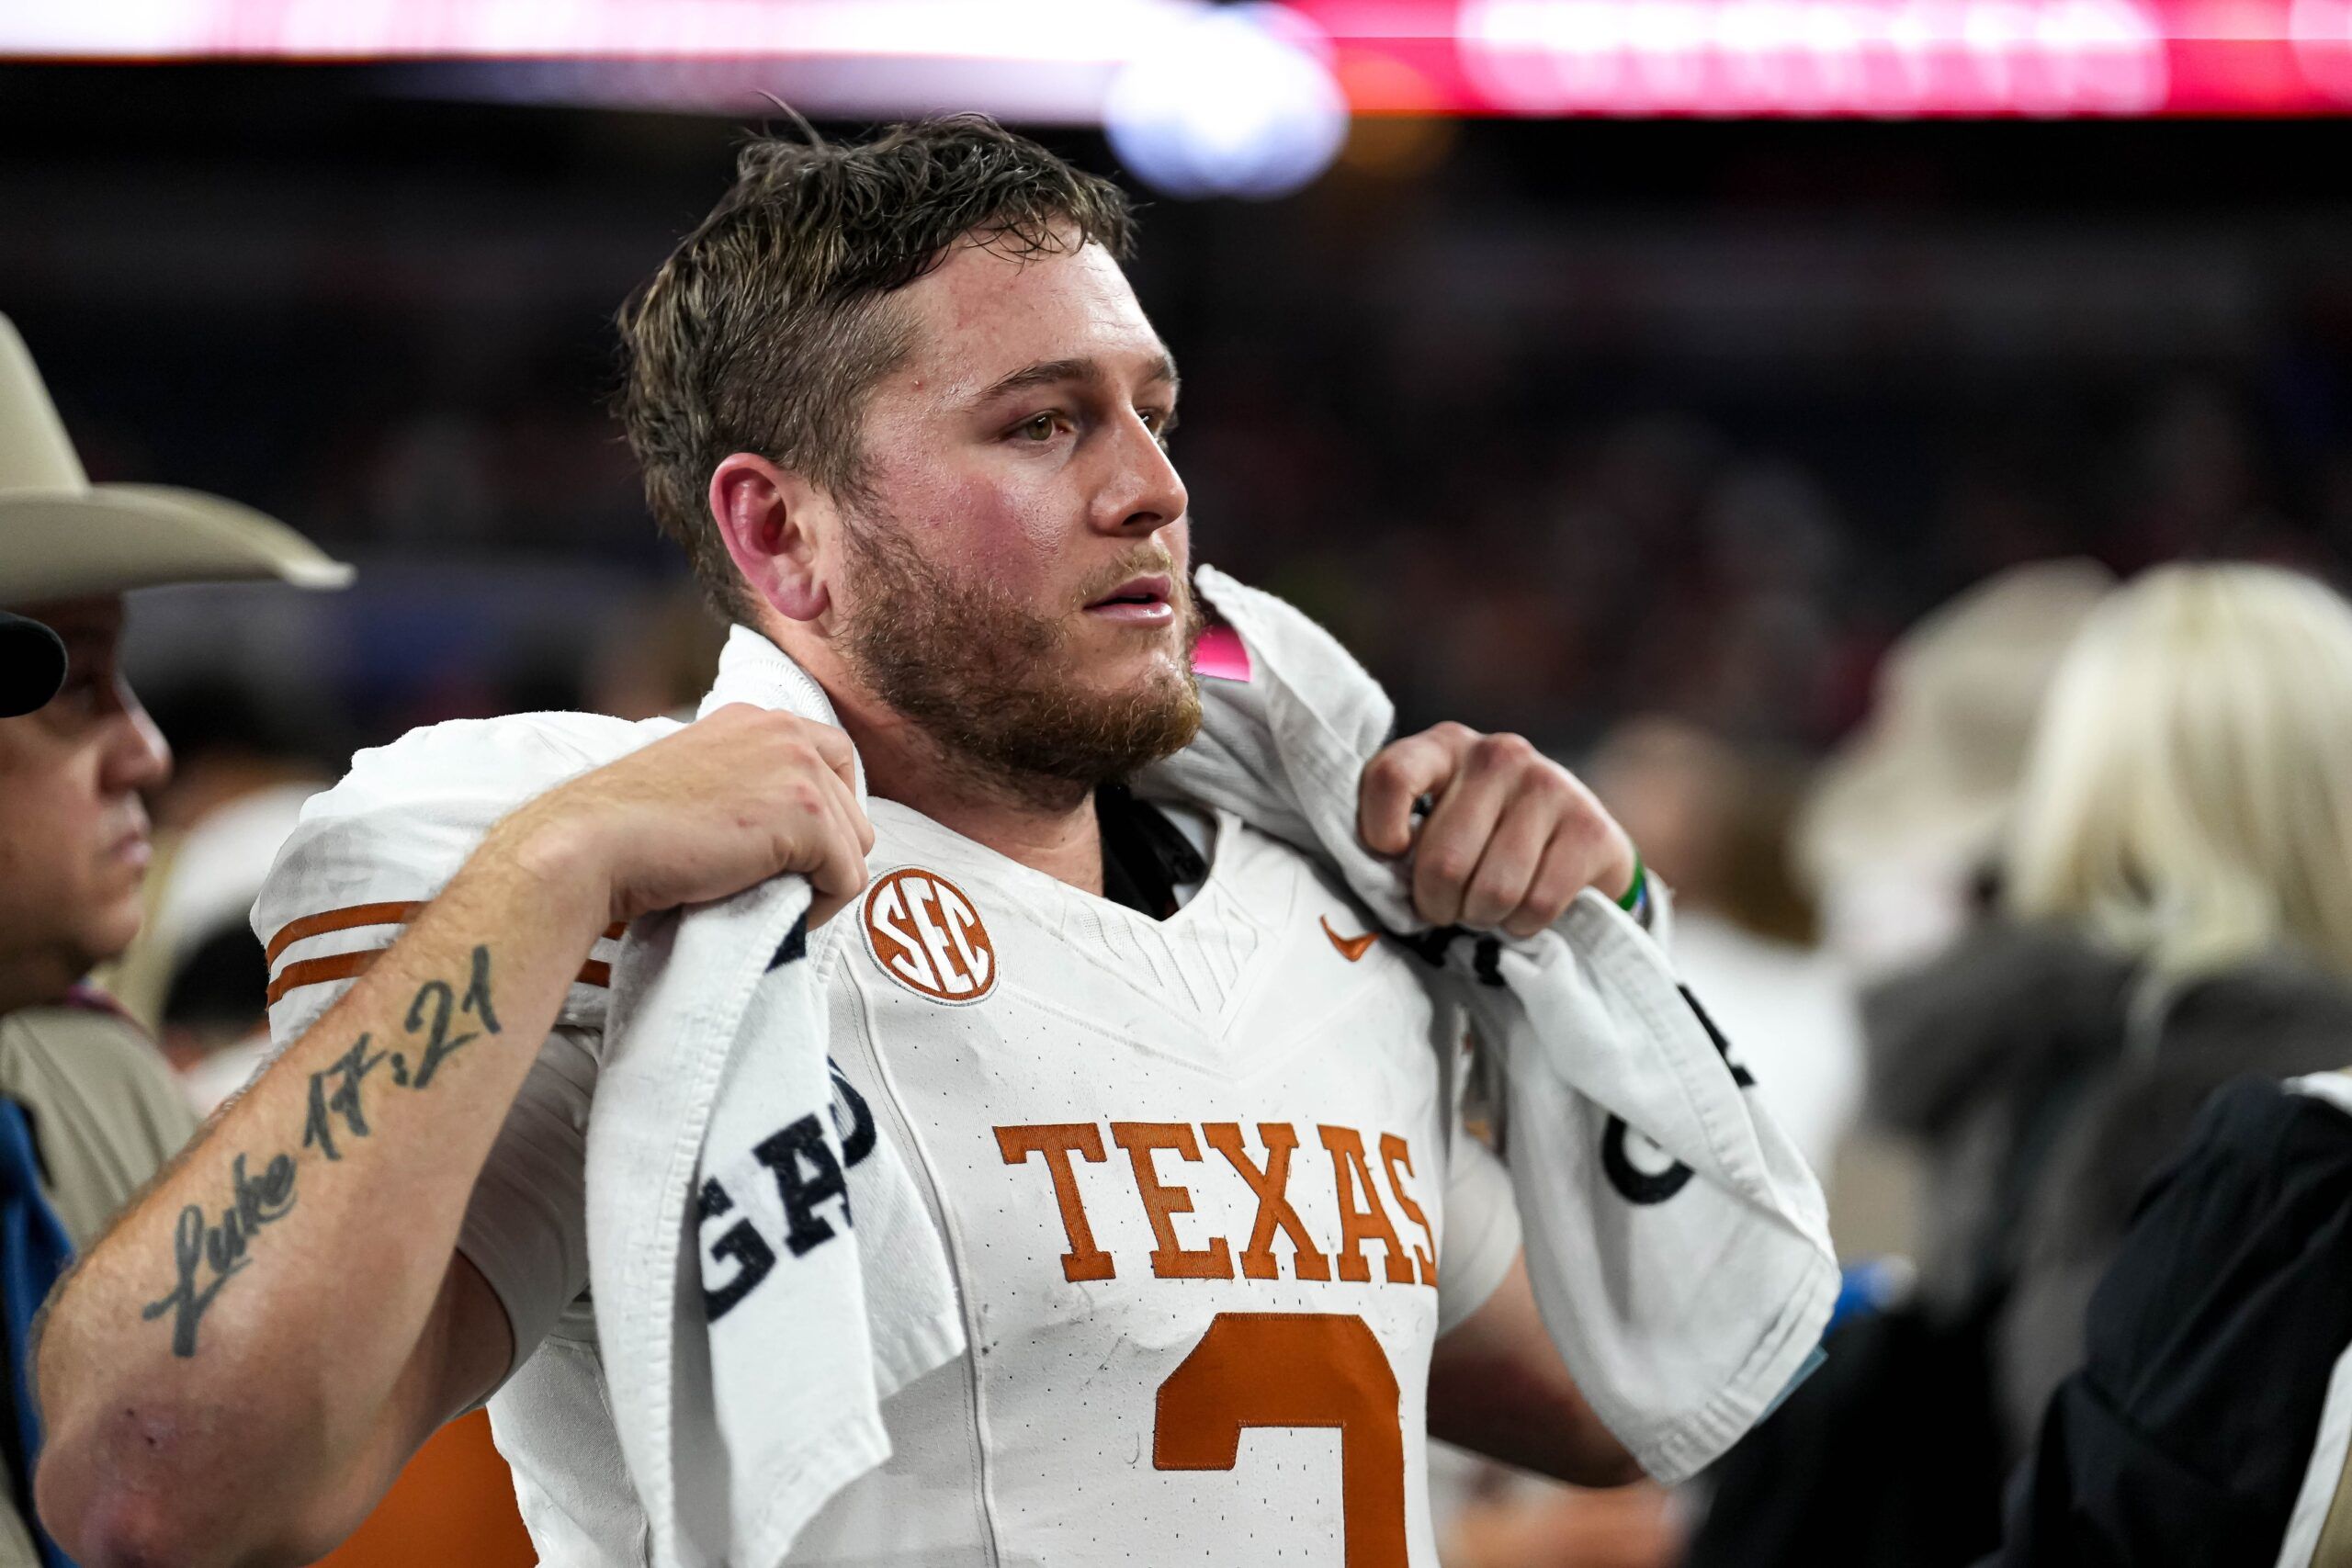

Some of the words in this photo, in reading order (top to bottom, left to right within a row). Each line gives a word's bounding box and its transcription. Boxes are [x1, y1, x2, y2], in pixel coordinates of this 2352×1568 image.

[871, 875, 989, 994] SEC
[142, 1152, 297, 1358] Luke
[302, 944, 502, 1161] 17:21
[991, 1122, 1438, 1289] TEXAS
